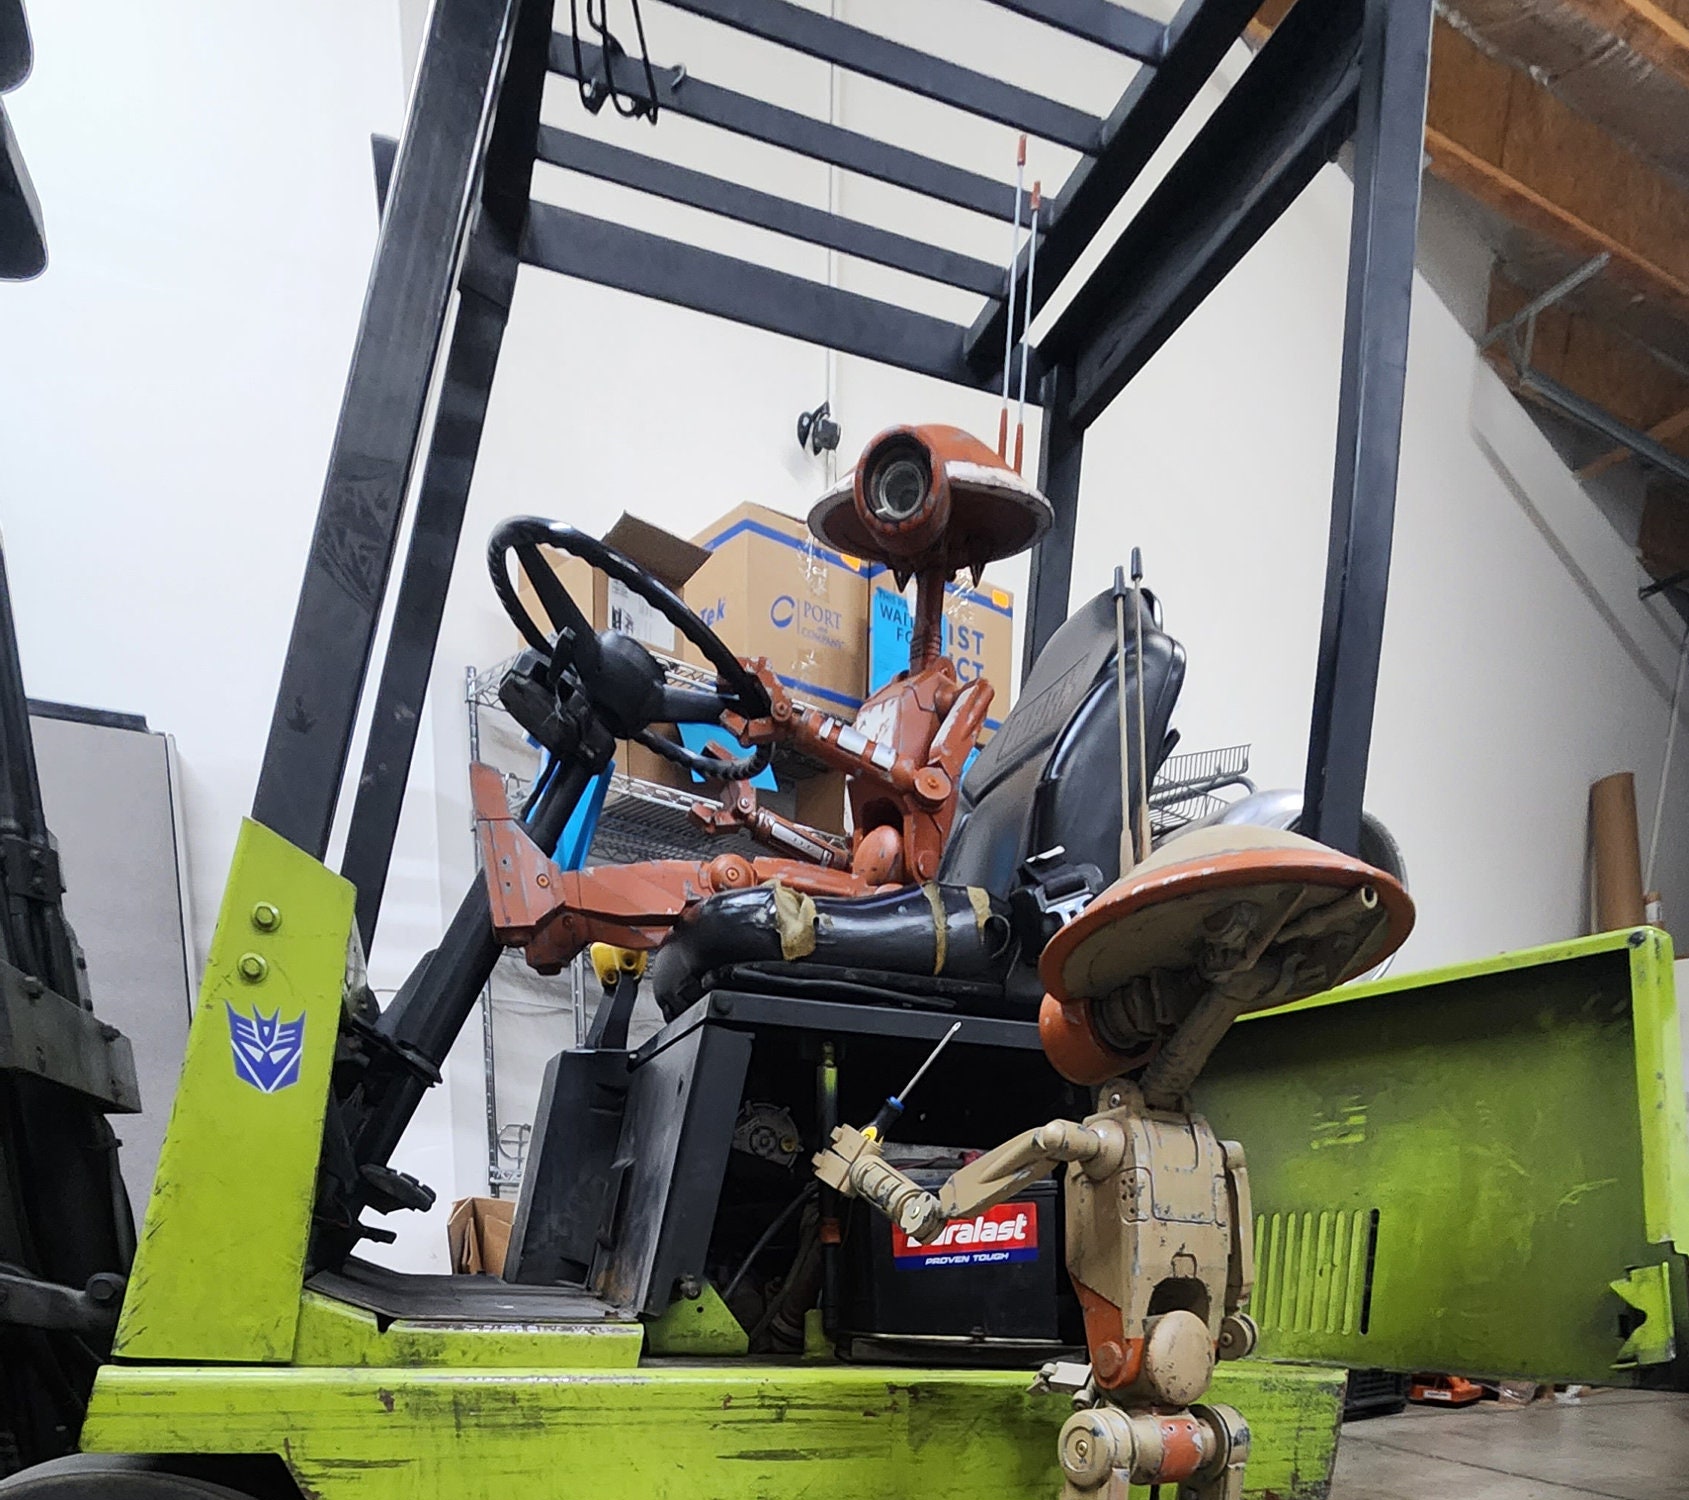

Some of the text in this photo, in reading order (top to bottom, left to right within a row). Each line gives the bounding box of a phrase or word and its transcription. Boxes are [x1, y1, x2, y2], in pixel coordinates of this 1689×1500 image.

[803, 600, 842, 630] PORT
[949, 653, 984, 682] CT
[906, 1213, 1028, 1248] ralast
[925, 1252, 1009, 1265] PROVEN TOUGH
